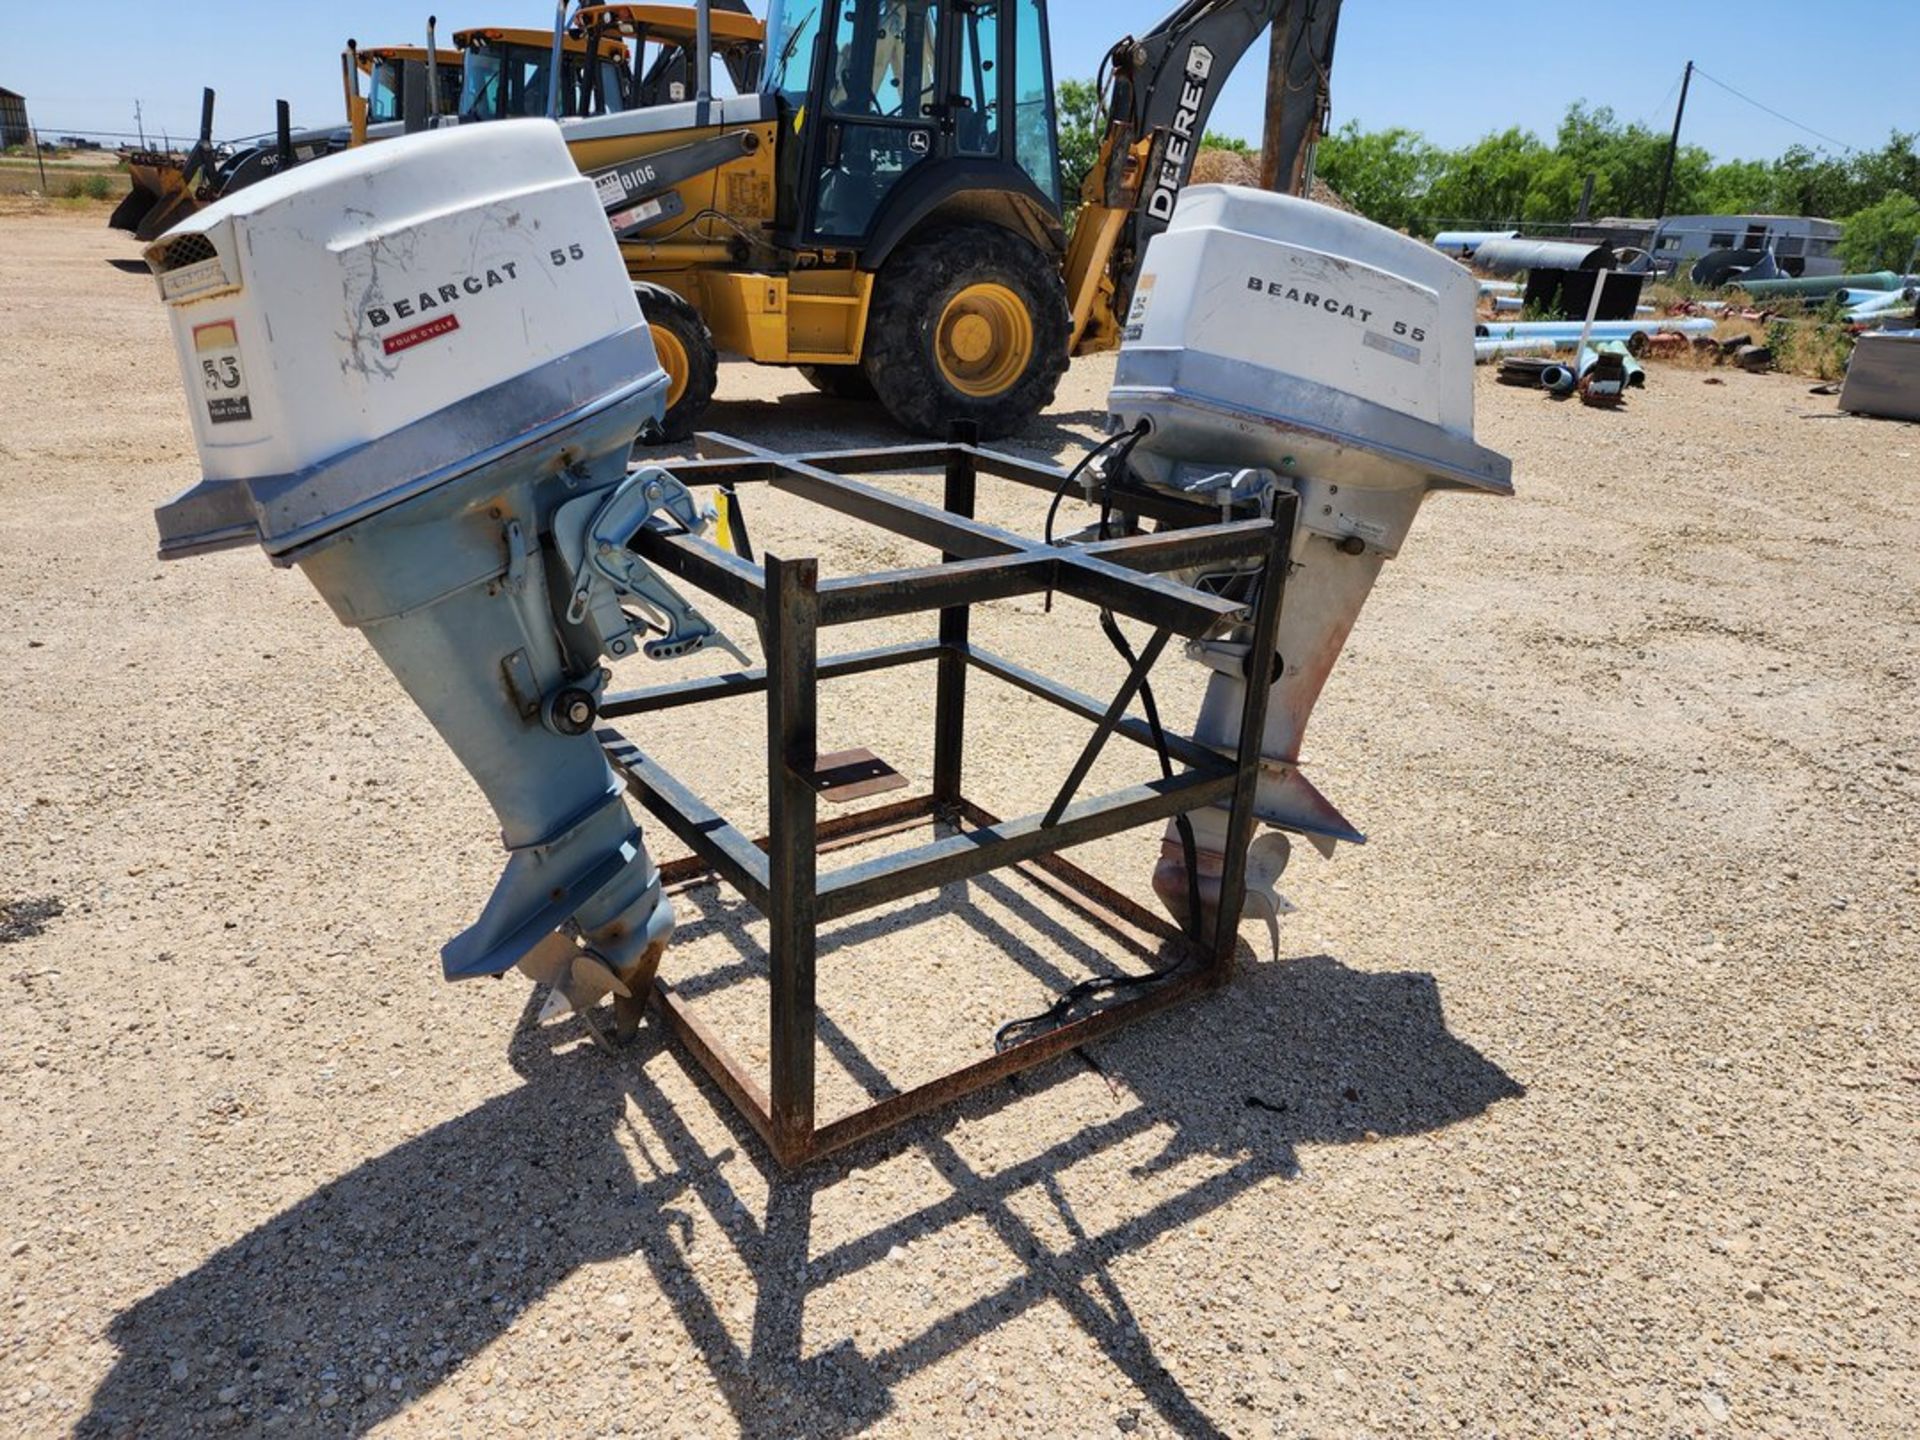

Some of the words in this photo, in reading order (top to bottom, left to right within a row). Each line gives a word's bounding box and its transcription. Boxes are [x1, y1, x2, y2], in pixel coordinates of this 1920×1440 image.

[1148, 81, 1204, 222] DEERE
[367, 262, 517, 328] BEARCAT
[550, 243, 584, 267] 55
[1247, 276, 1373, 322] BEARCAT
[1392, 321, 1426, 342] 55
[388, 333, 418, 349] FOUR
[421, 320, 454, 337] CYCLE
